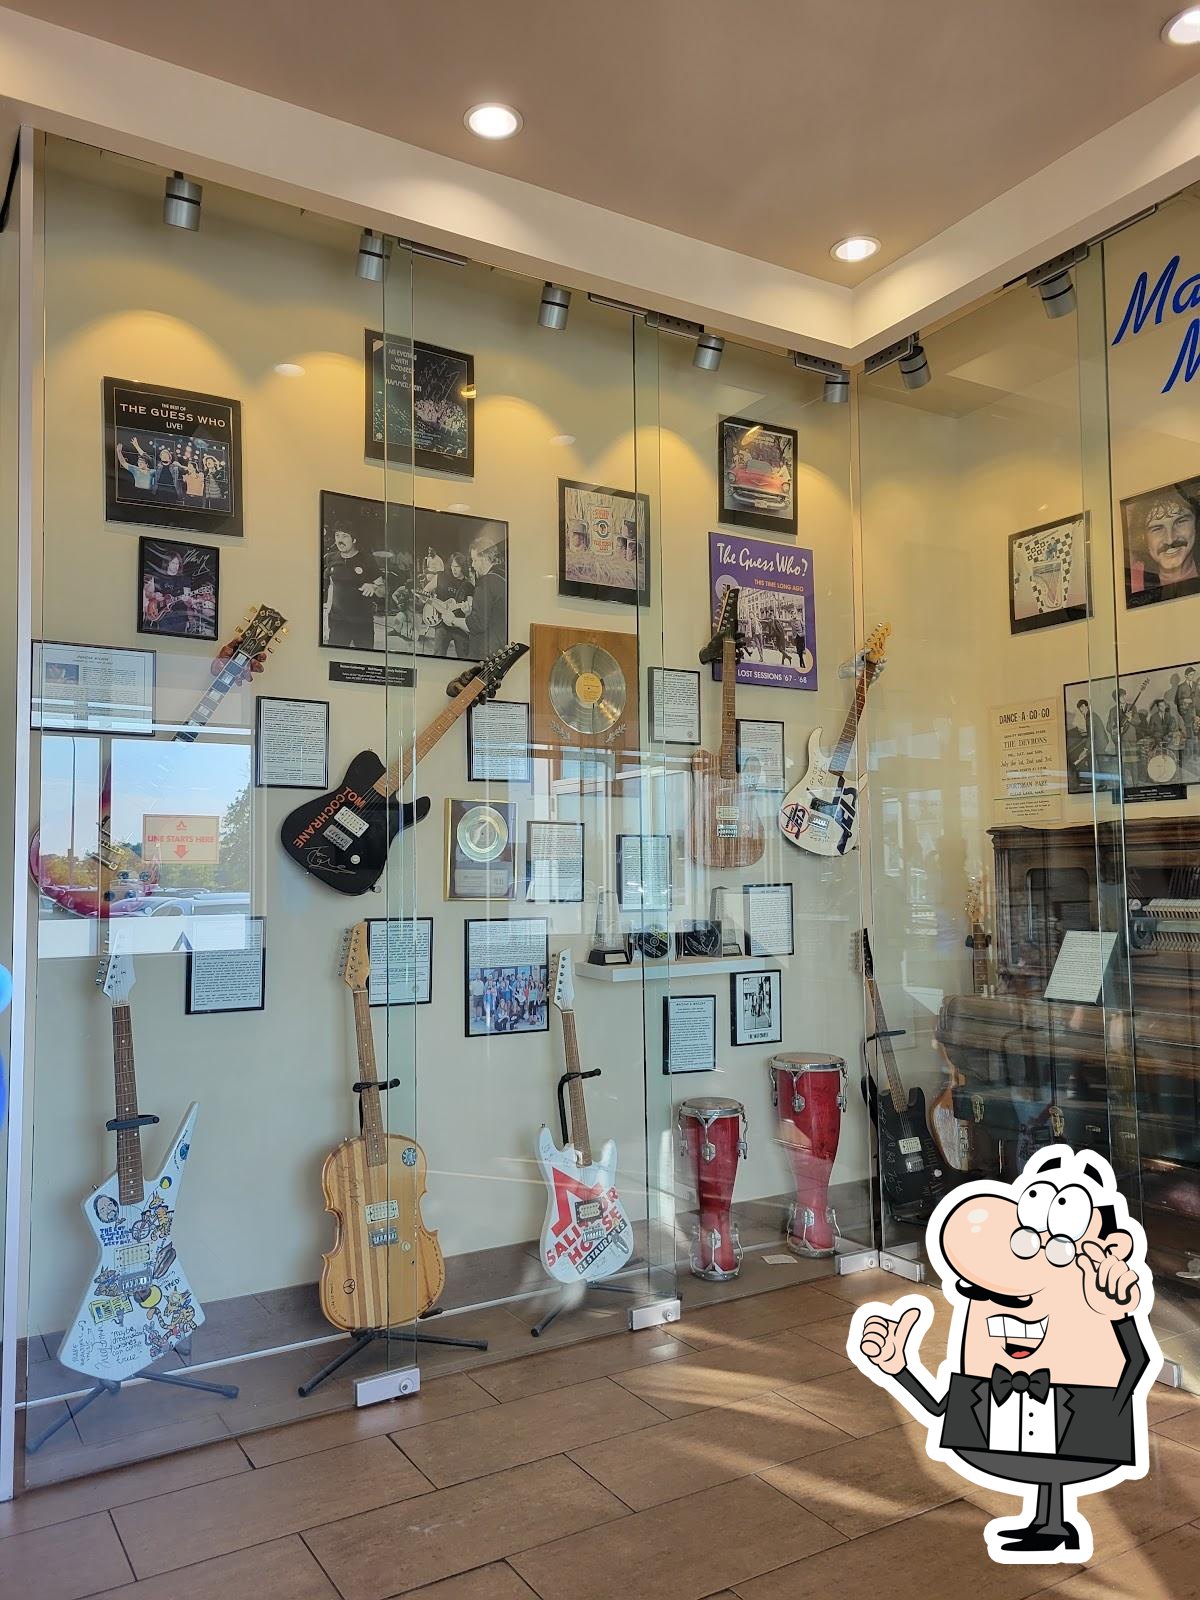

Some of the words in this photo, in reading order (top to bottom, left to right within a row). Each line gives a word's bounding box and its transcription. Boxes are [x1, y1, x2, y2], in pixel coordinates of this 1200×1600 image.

[120, 403, 147, 415] THE
[151, 408, 194, 422] GUESS
[198, 415, 226, 428] WHO
[166, 421, 183, 430] LIVE!
[716, 542, 736, 564] The
[739, 548, 774, 572] Guess
[776, 552, 808, 576] Who?
[777, 582, 791, 590] LONG
[792, 583, 804, 592] AGO
[738, 669, 752, 678] LOST
[754, 671, 782, 680] SESSIONS
[999, 713, 1018, 724] DANCE
[1029, 710, 1037, 720] GO
[1041, 708, 1050, 718] GO
[343, 787, 366, 808] TOM
[293, 794, 345, 849] COCHRANE
[567, 1206, 622, 1266] HOSE
[577, 1220, 627, 1273] RESTAURATS
